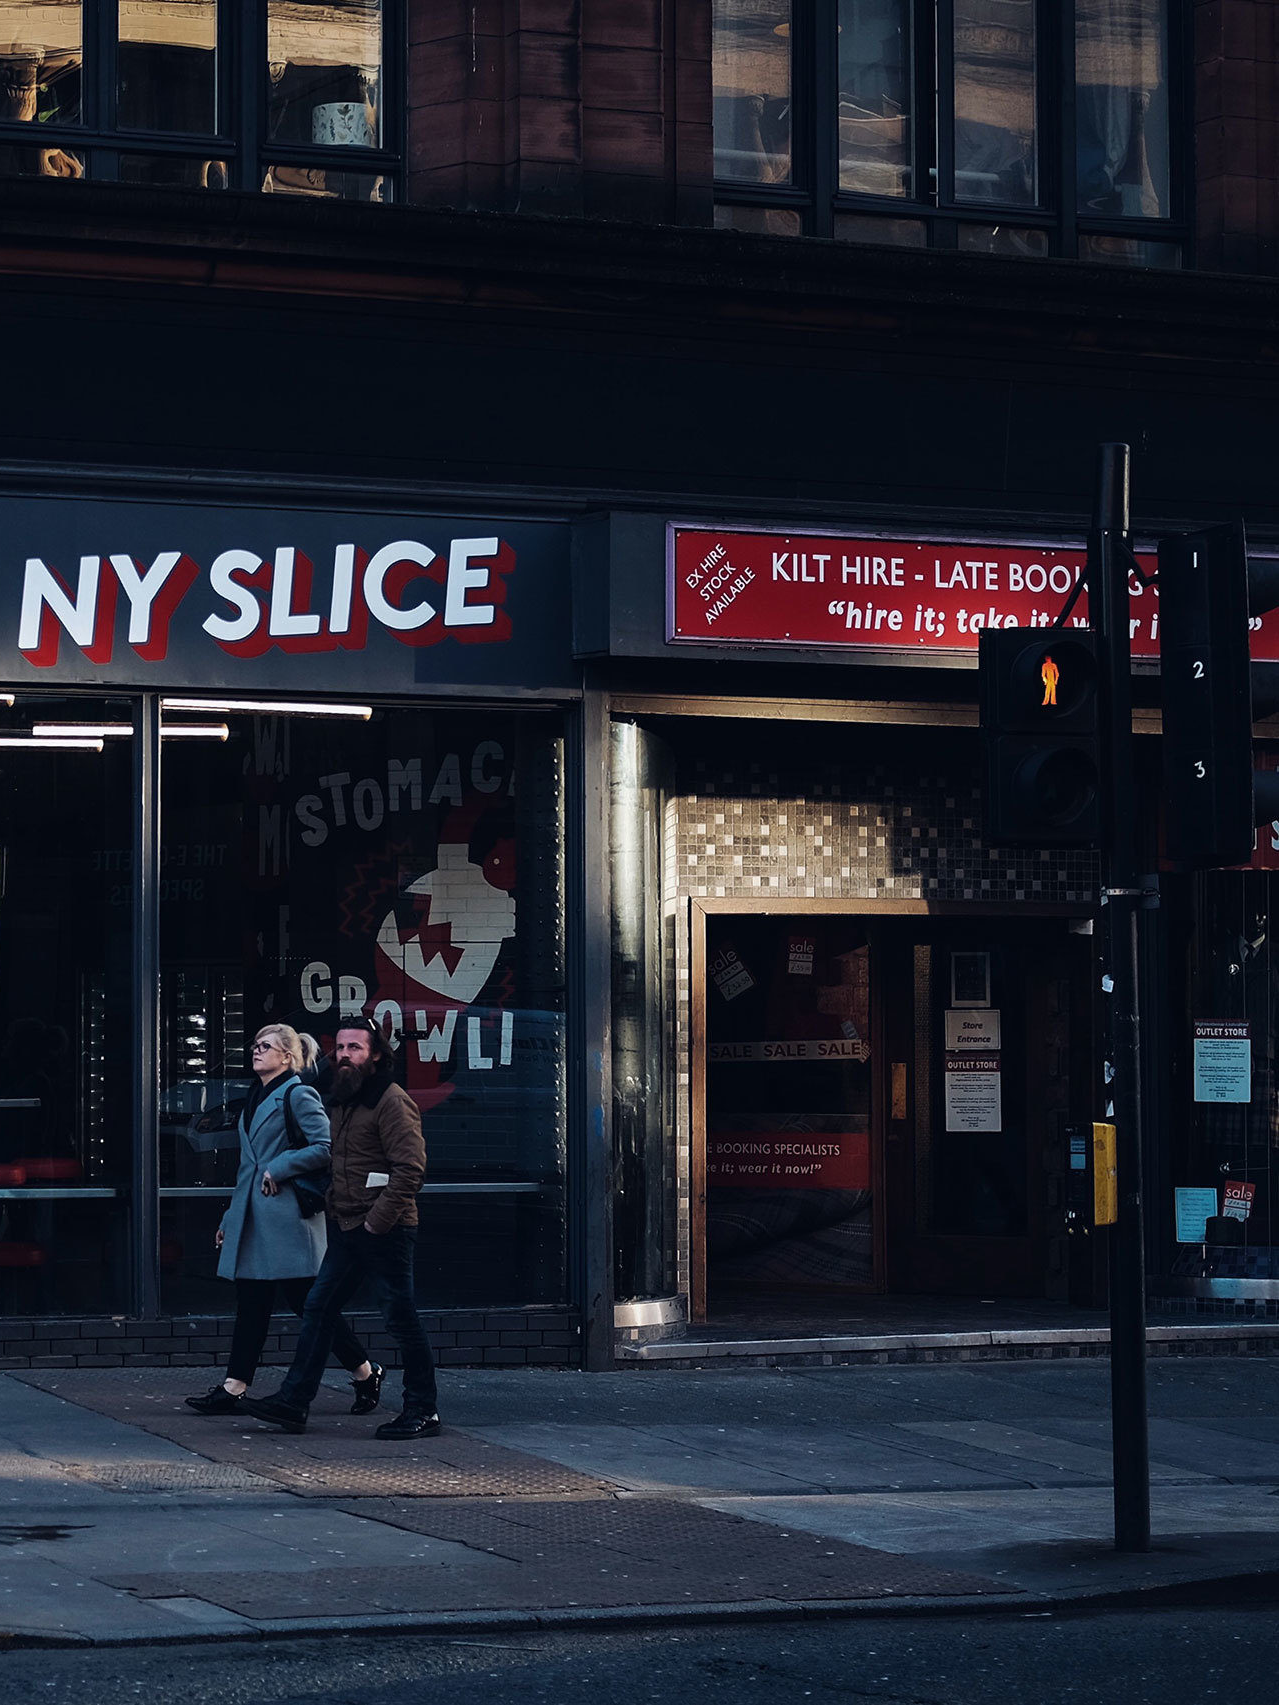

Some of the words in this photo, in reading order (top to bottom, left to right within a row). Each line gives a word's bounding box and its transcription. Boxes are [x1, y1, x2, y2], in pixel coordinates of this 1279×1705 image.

[685, 568, 704, 589] EX
[700, 543, 727, 574] HIRE
[772, 552, 831, 583] KILT
[841, 555, 905, 587] HIRE
[934, 559, 999, 590] LATE
[699, 561, 737, 601] STOCK
[18, 550, 191, 660] NY
[201, 537, 507, 650] SLICE
[704, 566, 756, 625] AVAILABLE
[914, 604, 946, 638] it;
[1192, 660, 1205, 679] 2
[1193, 760, 1206, 779] 3
[294, 739, 516, 847] STOMAC
[789, 939, 815, 954] sale
[962, 1021, 983, 1030] Store
[1196, 1027, 1223, 1036] OUTLET
[1224, 1027, 1248, 1036] STORE
[957, 1035, 991, 1043] Entrance
[711, 1045, 753, 1058] SALE
[763, 1044, 806, 1057] SALE
[817, 1042, 861, 1056] SALE
[947, 1061, 975, 1069] OUTLET
[976, 1061, 998, 1069] STORE
[717, 1143, 771, 1154] BOOKING
[774, 1143, 841, 1156] SPECIALISTS
[738, 1164, 768, 1174] wear
[771, 1163, 782, 1174] it
[1225, 1185, 1252, 1200] sale
